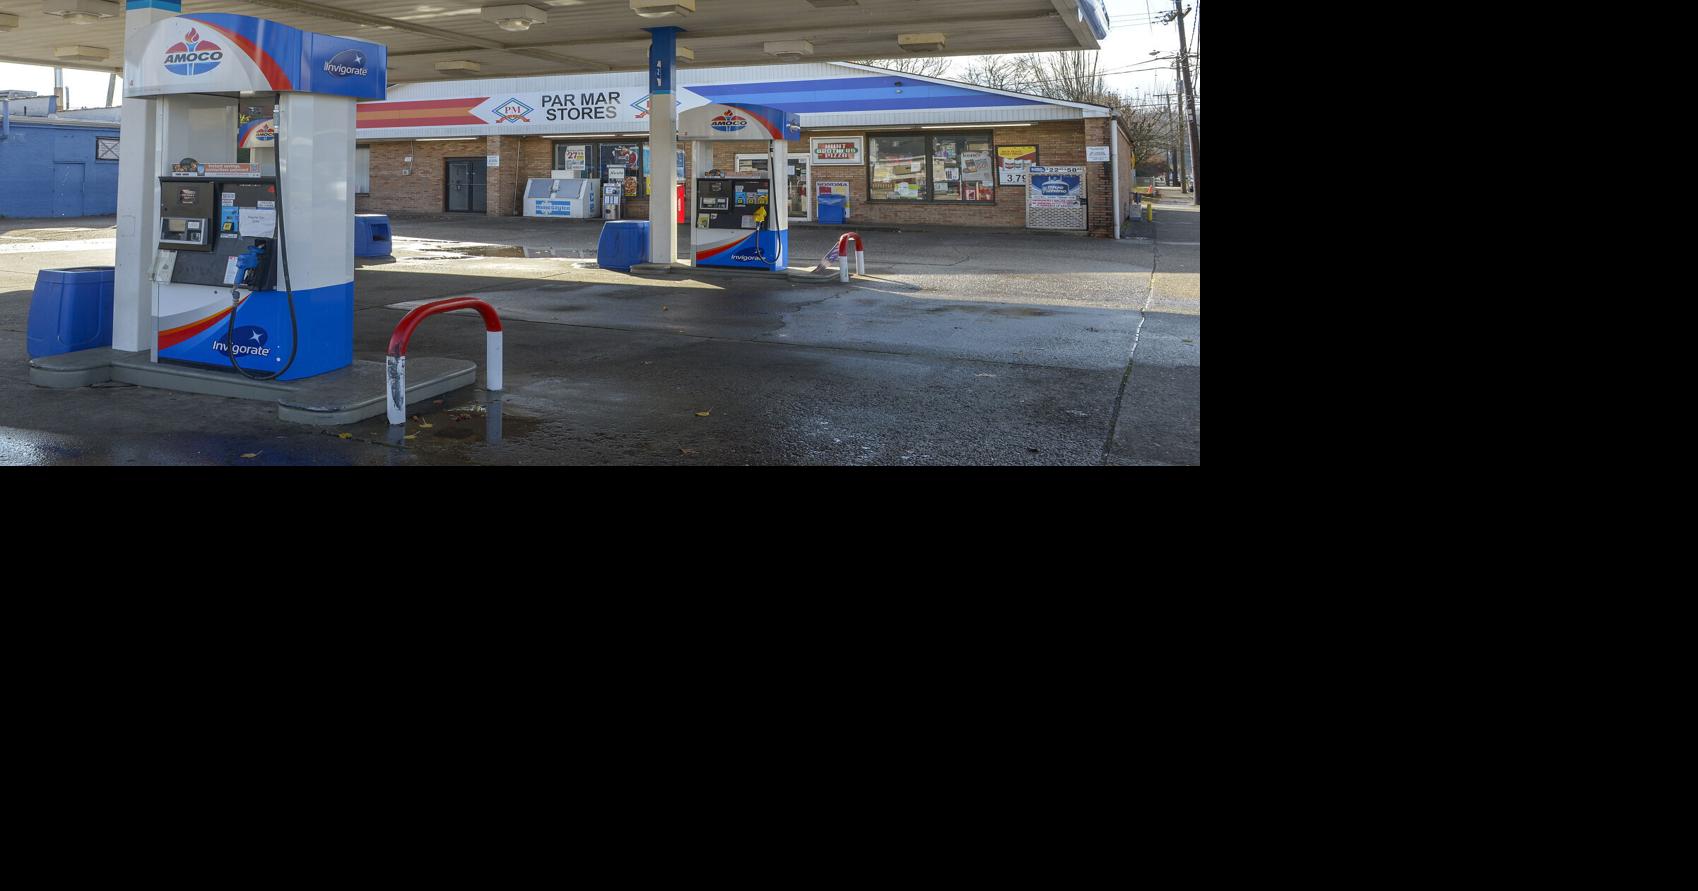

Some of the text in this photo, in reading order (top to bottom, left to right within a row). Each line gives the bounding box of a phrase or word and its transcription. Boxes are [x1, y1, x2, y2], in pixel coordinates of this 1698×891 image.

[164, 51, 223, 64] AMOCO
[326, 63, 368, 76] Invigorate
[541, 91, 621, 108] PAR MAR
[504, 106, 521, 114] PM
[546, 105, 617, 121] STORES
